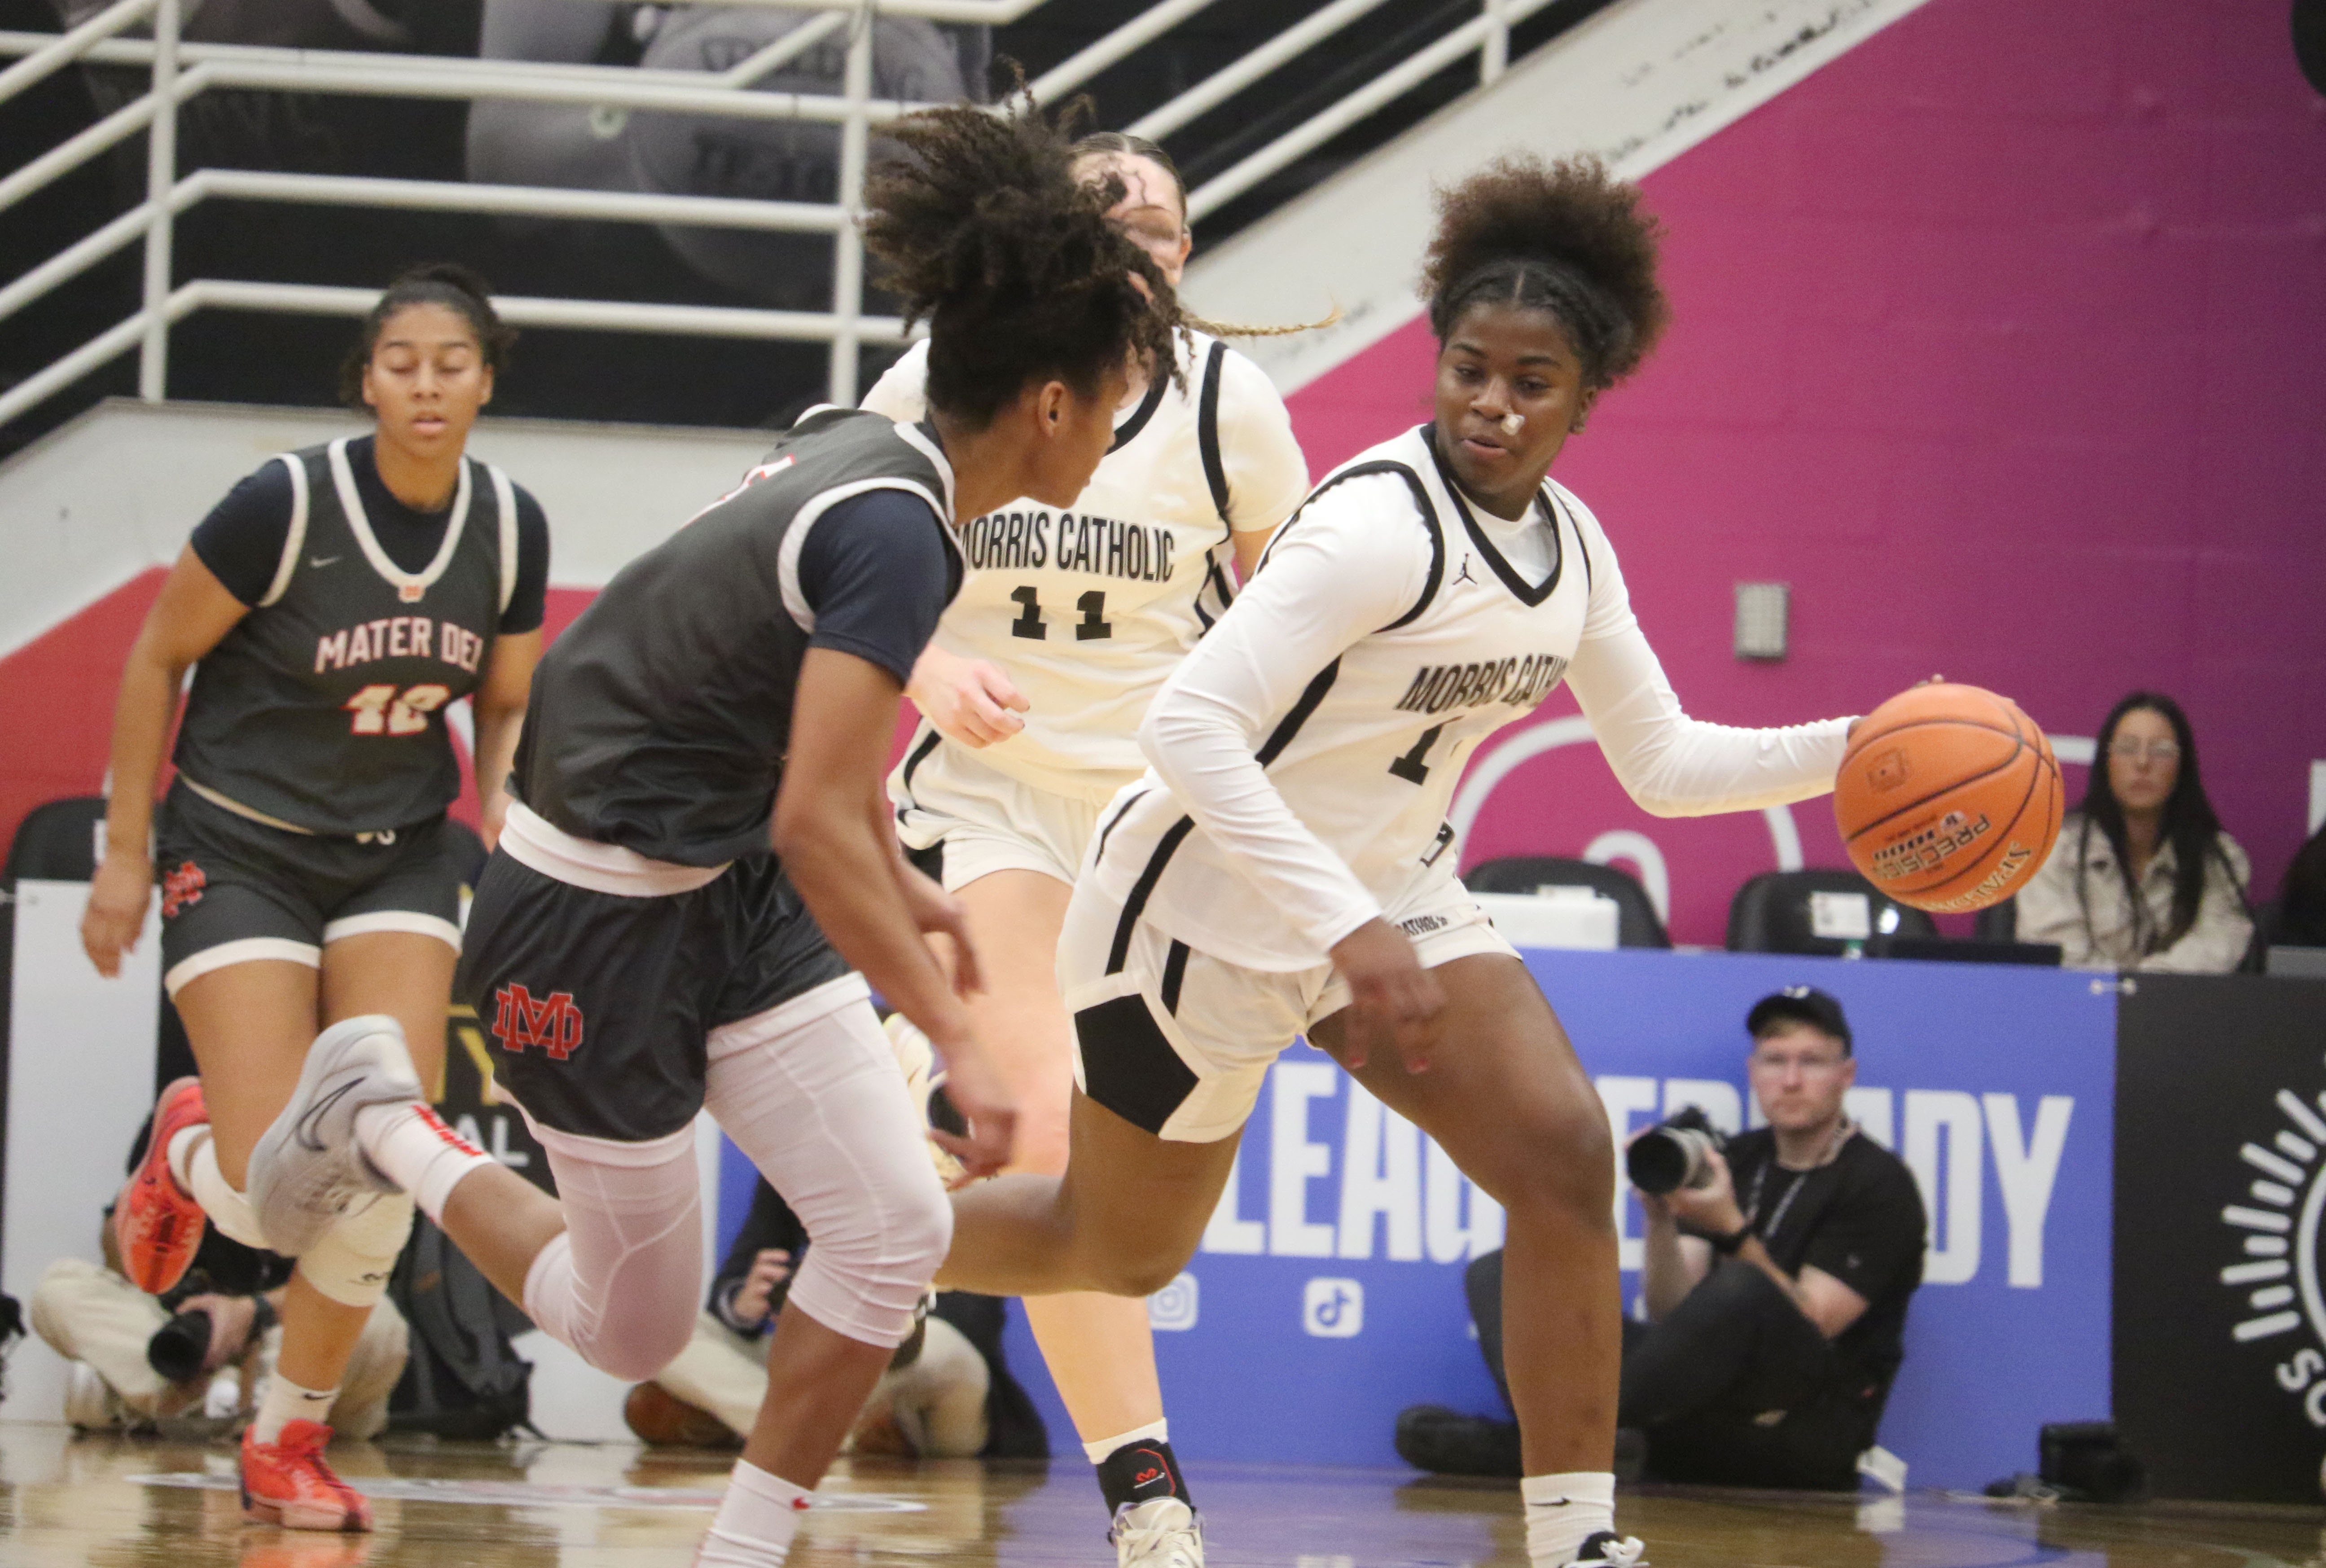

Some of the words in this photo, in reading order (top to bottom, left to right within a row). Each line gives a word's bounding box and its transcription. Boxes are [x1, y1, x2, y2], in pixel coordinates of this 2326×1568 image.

[1056, 513, 1175, 582] CATHOLIC
[1011, 585, 1112, 640] 11
[315, 617, 433, 673] MATER
[440, 622, 483, 673] DEI
[1392, 656, 1517, 715] MORRIS
[1388, 716, 1465, 786] 1
